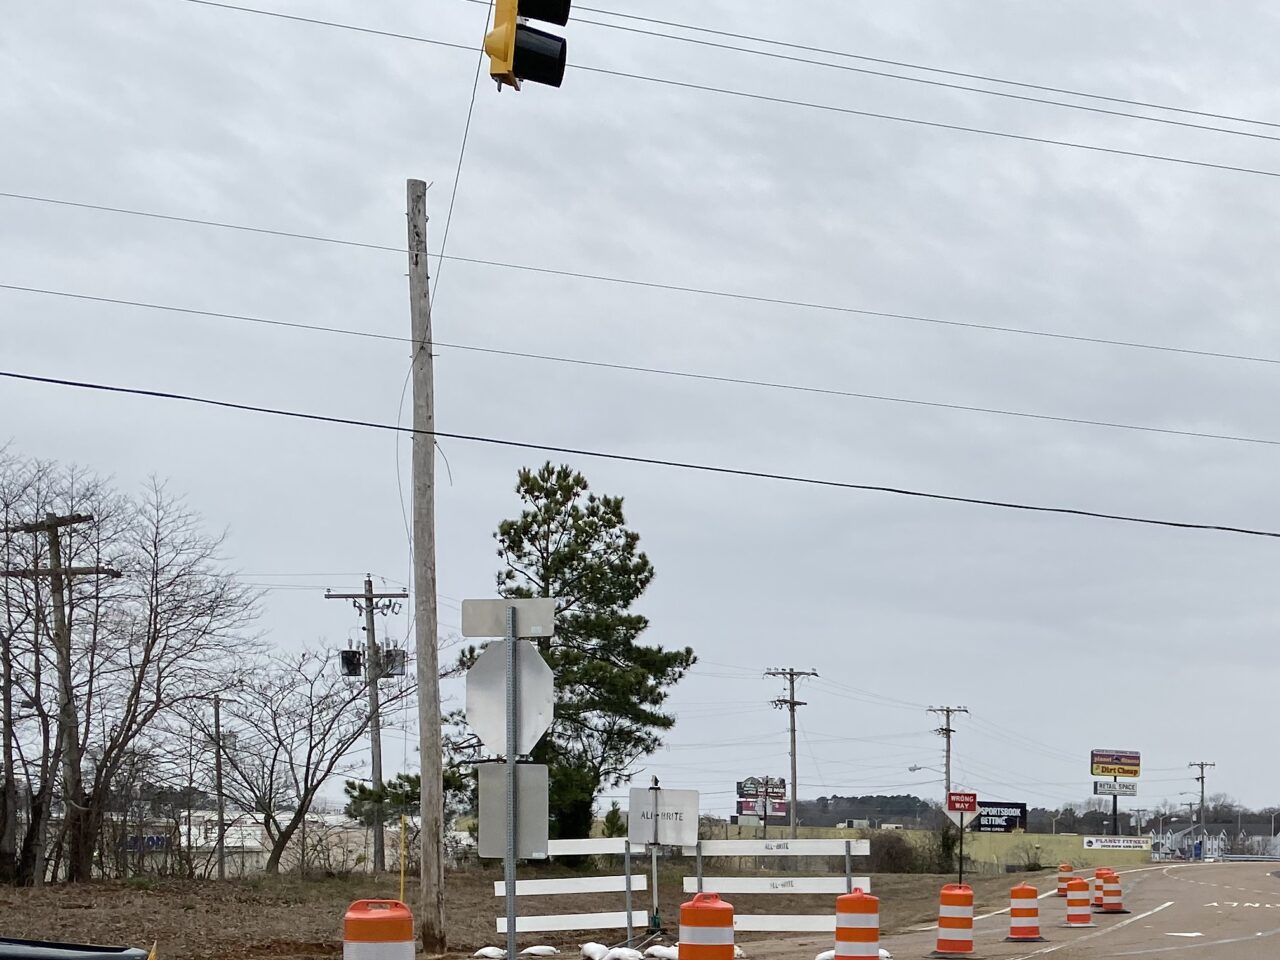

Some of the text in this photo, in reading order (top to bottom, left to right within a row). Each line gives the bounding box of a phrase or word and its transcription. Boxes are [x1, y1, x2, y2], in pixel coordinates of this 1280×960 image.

[1101, 766, 1138, 776] Dirt Cheap
[1118, 783, 1136, 791] SPACE
[640, 810, 684, 822] ALL-BRITE
[980, 807, 1022, 816] SPORTSBOOK
